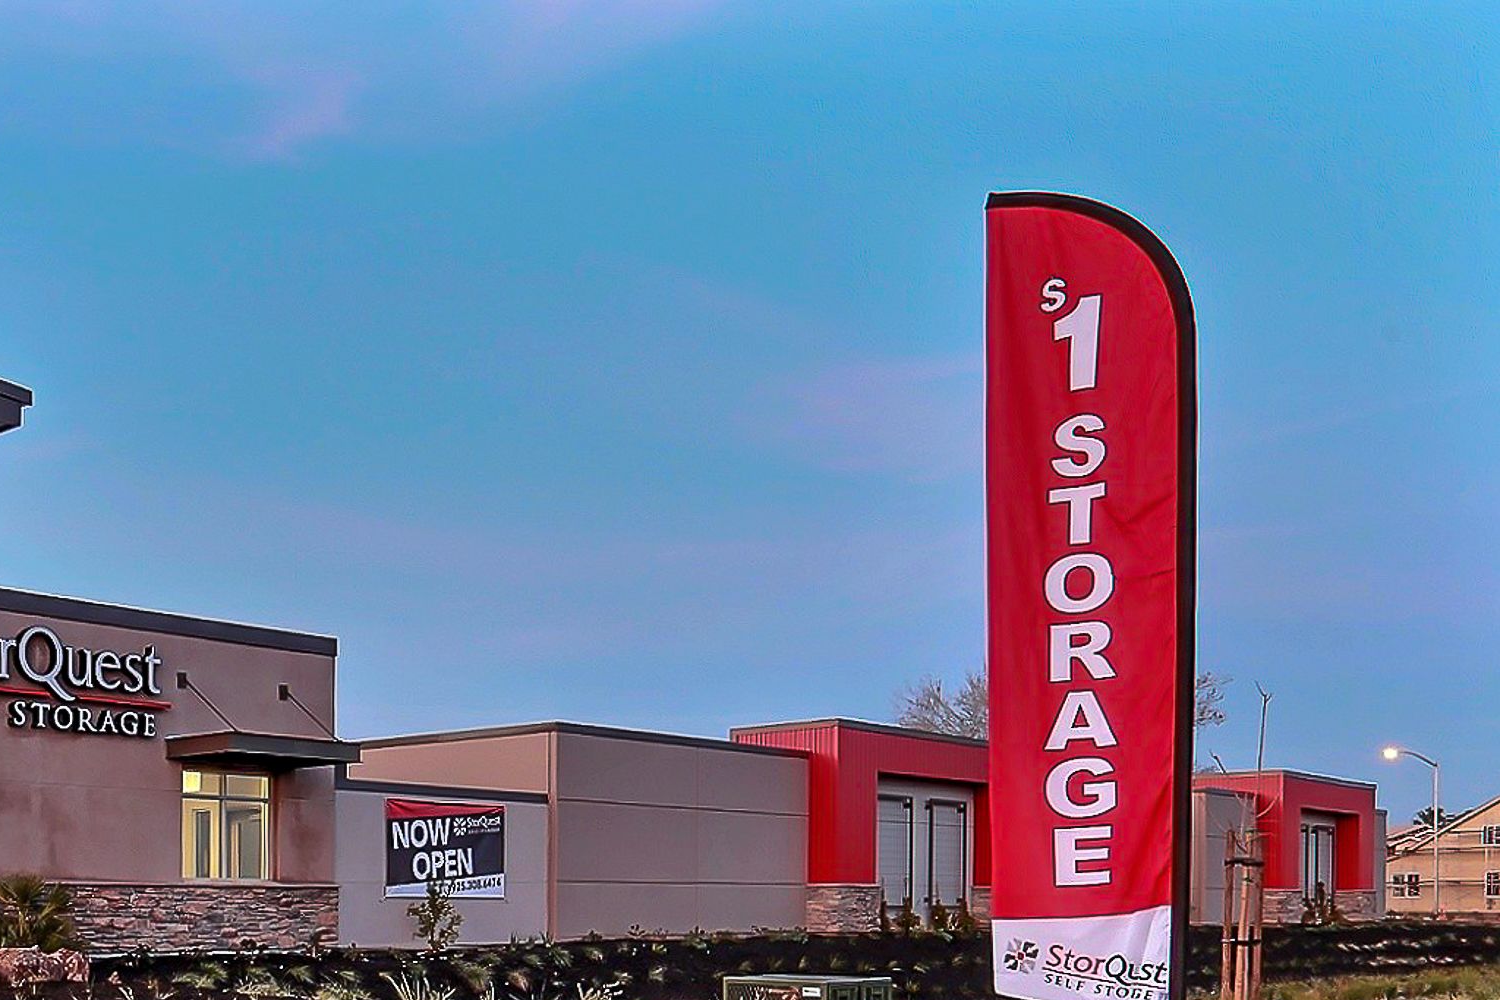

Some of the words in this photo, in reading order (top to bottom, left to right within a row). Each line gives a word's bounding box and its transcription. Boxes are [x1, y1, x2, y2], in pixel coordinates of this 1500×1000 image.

[1040, 276, 1102, 392] $1
[1044, 413, 1118, 887] STORAGE
[13, 701, 156, 737] STORAGE
[392, 818, 451, 849] NOW
[412, 848, 473, 880] OPEN
[1044, 974, 1086, 991] SELF
